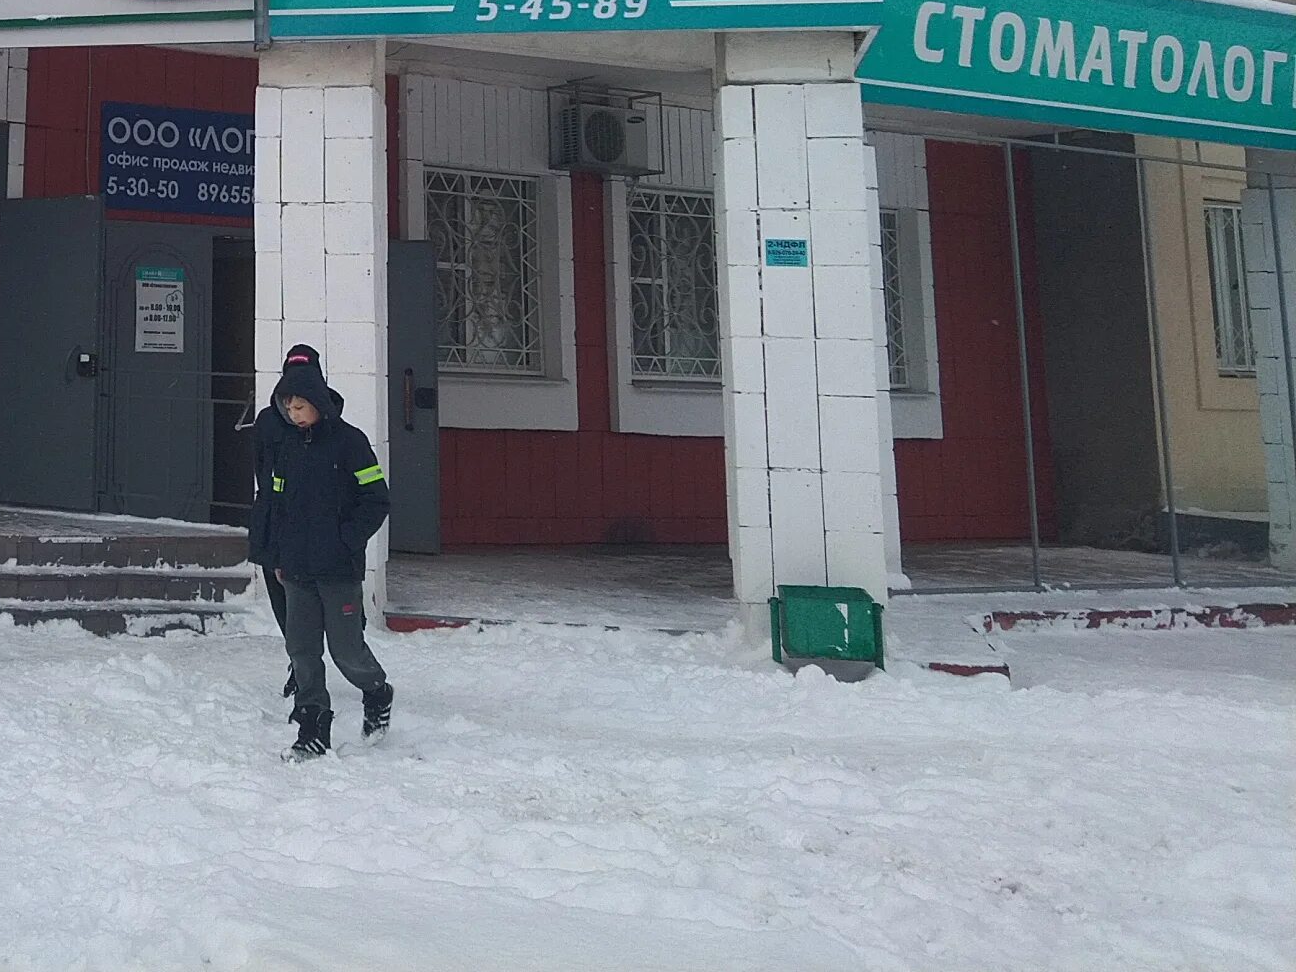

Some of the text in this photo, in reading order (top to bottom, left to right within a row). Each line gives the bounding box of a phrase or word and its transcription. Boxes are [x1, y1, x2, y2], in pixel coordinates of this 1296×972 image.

[913, 1, 1296, 109] СТОМАТОЛОГ
[107, 116, 180, 149] ООО
[107, 150, 149, 169] офис
[153, 156, 209, 173] продаж
[106, 176, 180, 199] 5-30-50
[767, 240, 806, 249] 2-НДФЛ
